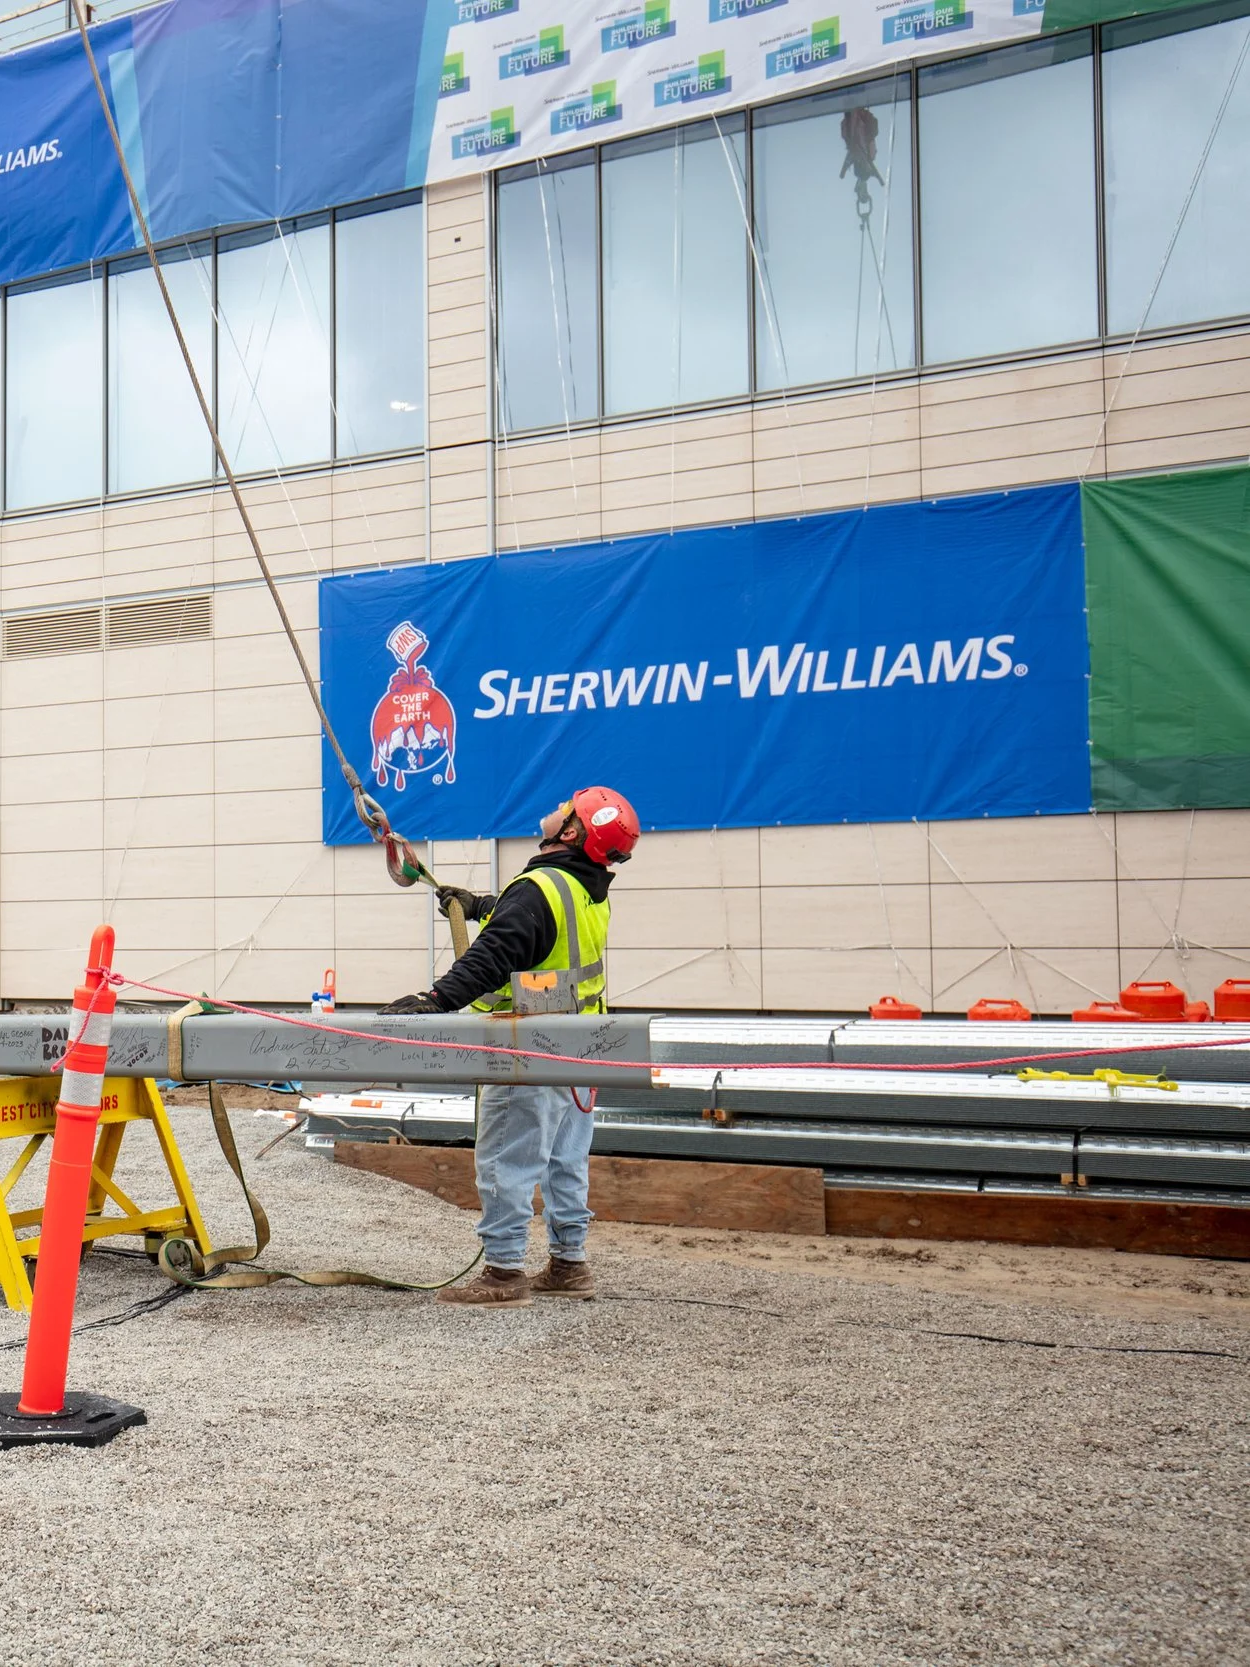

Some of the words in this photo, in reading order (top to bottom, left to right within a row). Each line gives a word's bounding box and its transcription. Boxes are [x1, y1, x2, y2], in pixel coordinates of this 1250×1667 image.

[935, 7, 954, 16] OUR
[610, 24, 661, 47] FUTURE
[893, 13, 954, 37] FUTURE
[507, 52, 556, 74] FUTURE
[775, 46, 830, 72] FUTURE
[663, 77, 716, 101] FUTURE
[559, 106, 607, 129] FUTURE
[459, 133, 507, 154] FUTURE
[395, 629, 418, 655] SWP
[392, 692, 430, 705] COVER
[402, 702, 422, 712] THE
[394, 711, 431, 723] EARTH
[455, 1048, 479, 1064] NYC
